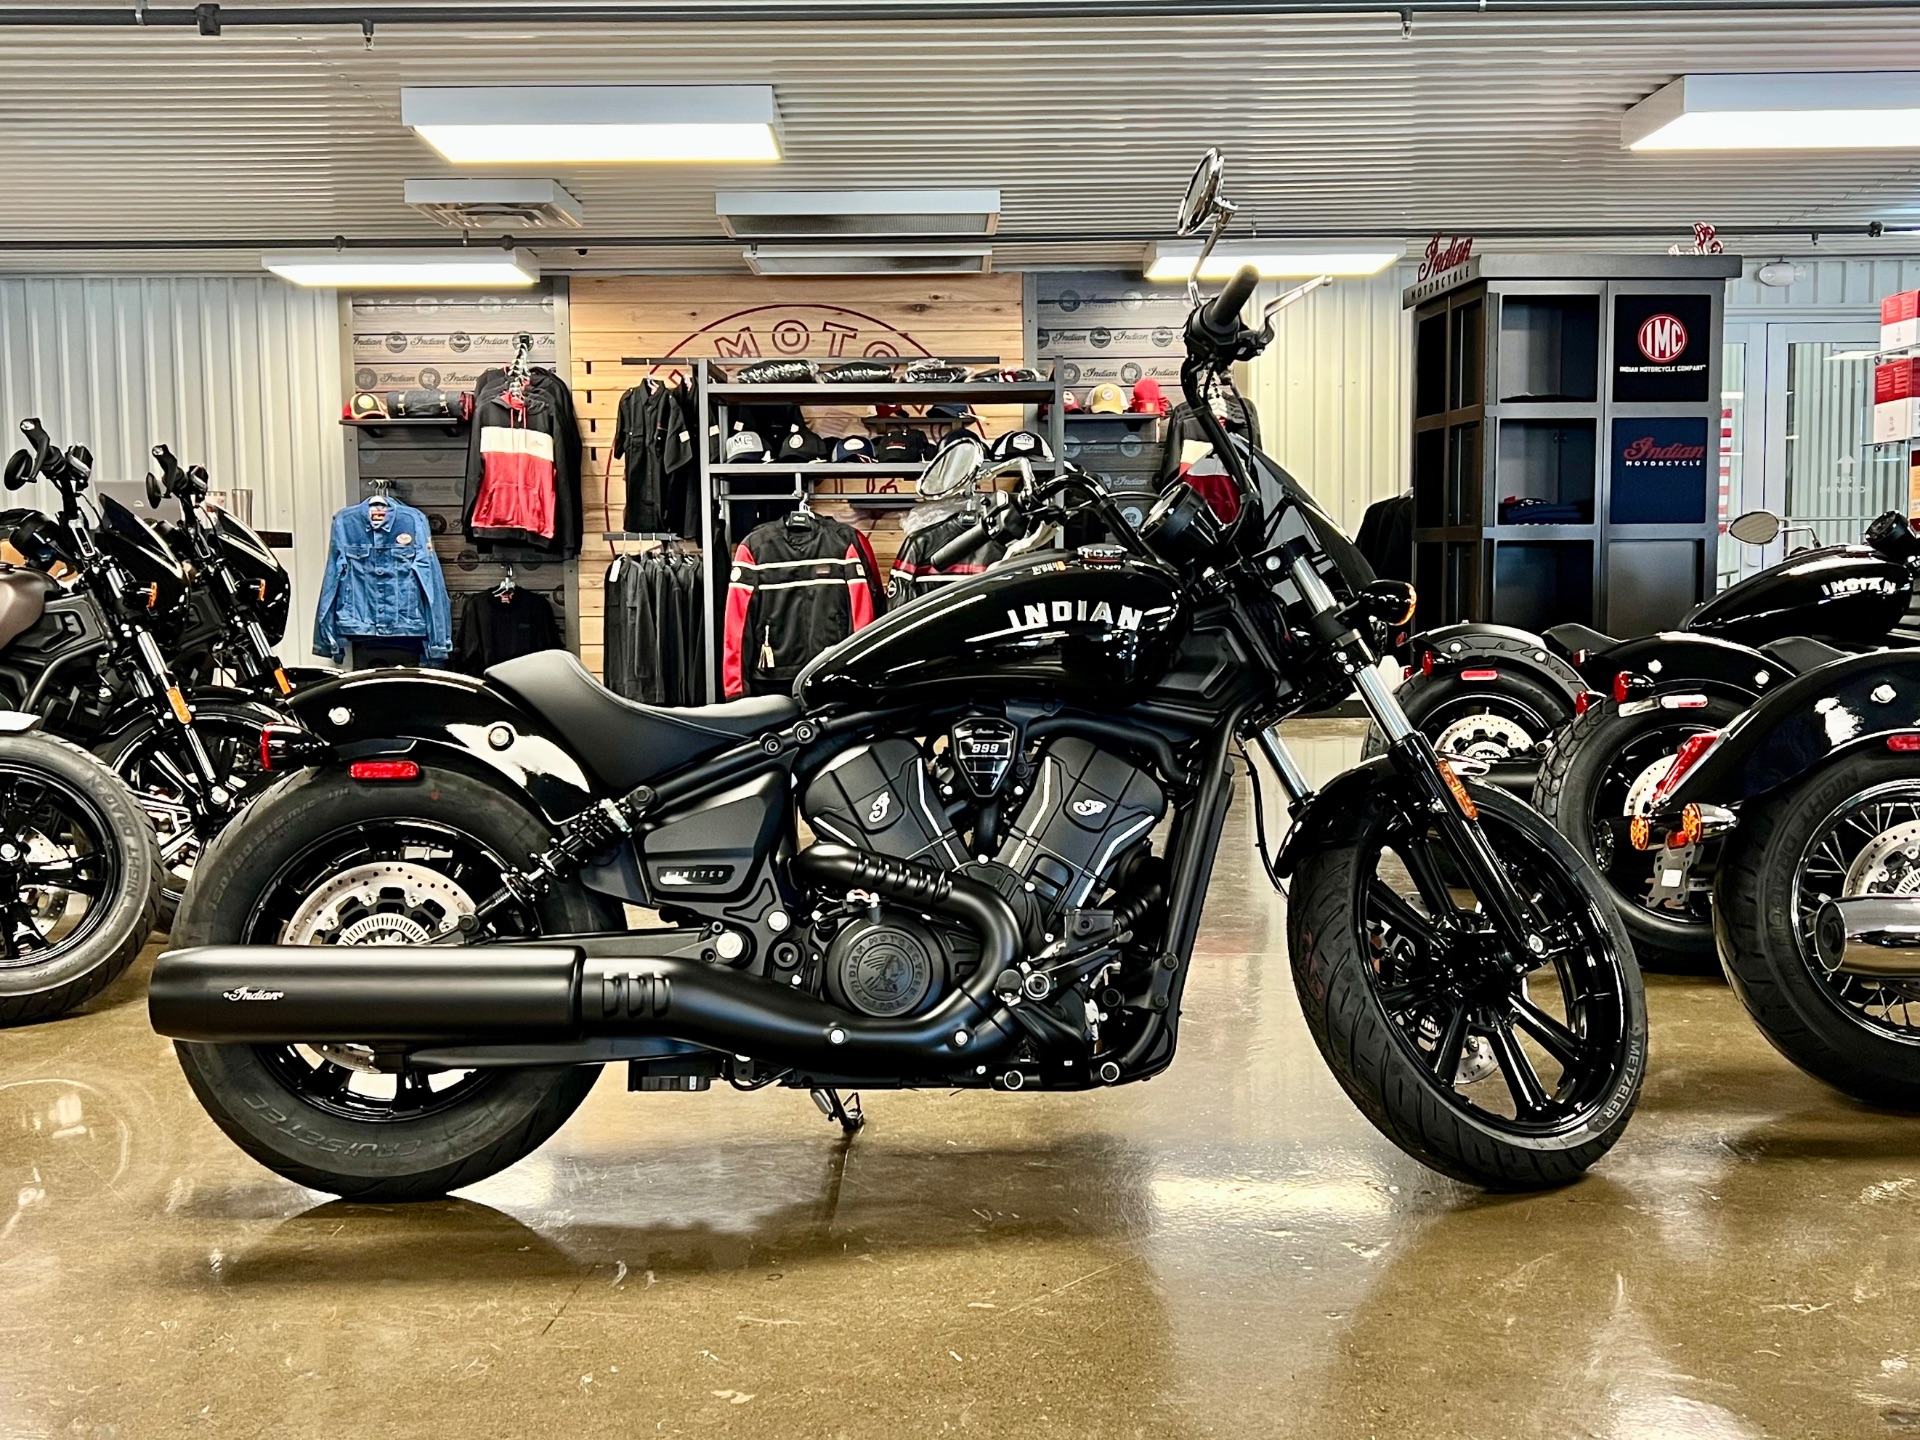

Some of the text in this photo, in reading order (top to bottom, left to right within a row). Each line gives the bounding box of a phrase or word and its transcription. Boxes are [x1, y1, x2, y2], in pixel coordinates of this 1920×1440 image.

[1418, 231, 1473, 283] Indian
[1411, 265, 1470, 300] MOTORCYCLE
[1646, 318, 1682, 358] IMC
[1623, 436, 1705, 460] Indian
[1006, 600, 1144, 631] INDIAN
[971, 743, 1000, 754] 999
[125, 844, 140, 899] NIGHT
[227, 986, 281, 1001] Indian
[1602, 1040, 1641, 1119] METZELER
[243, 1093, 421, 1158] CRUISETEC
